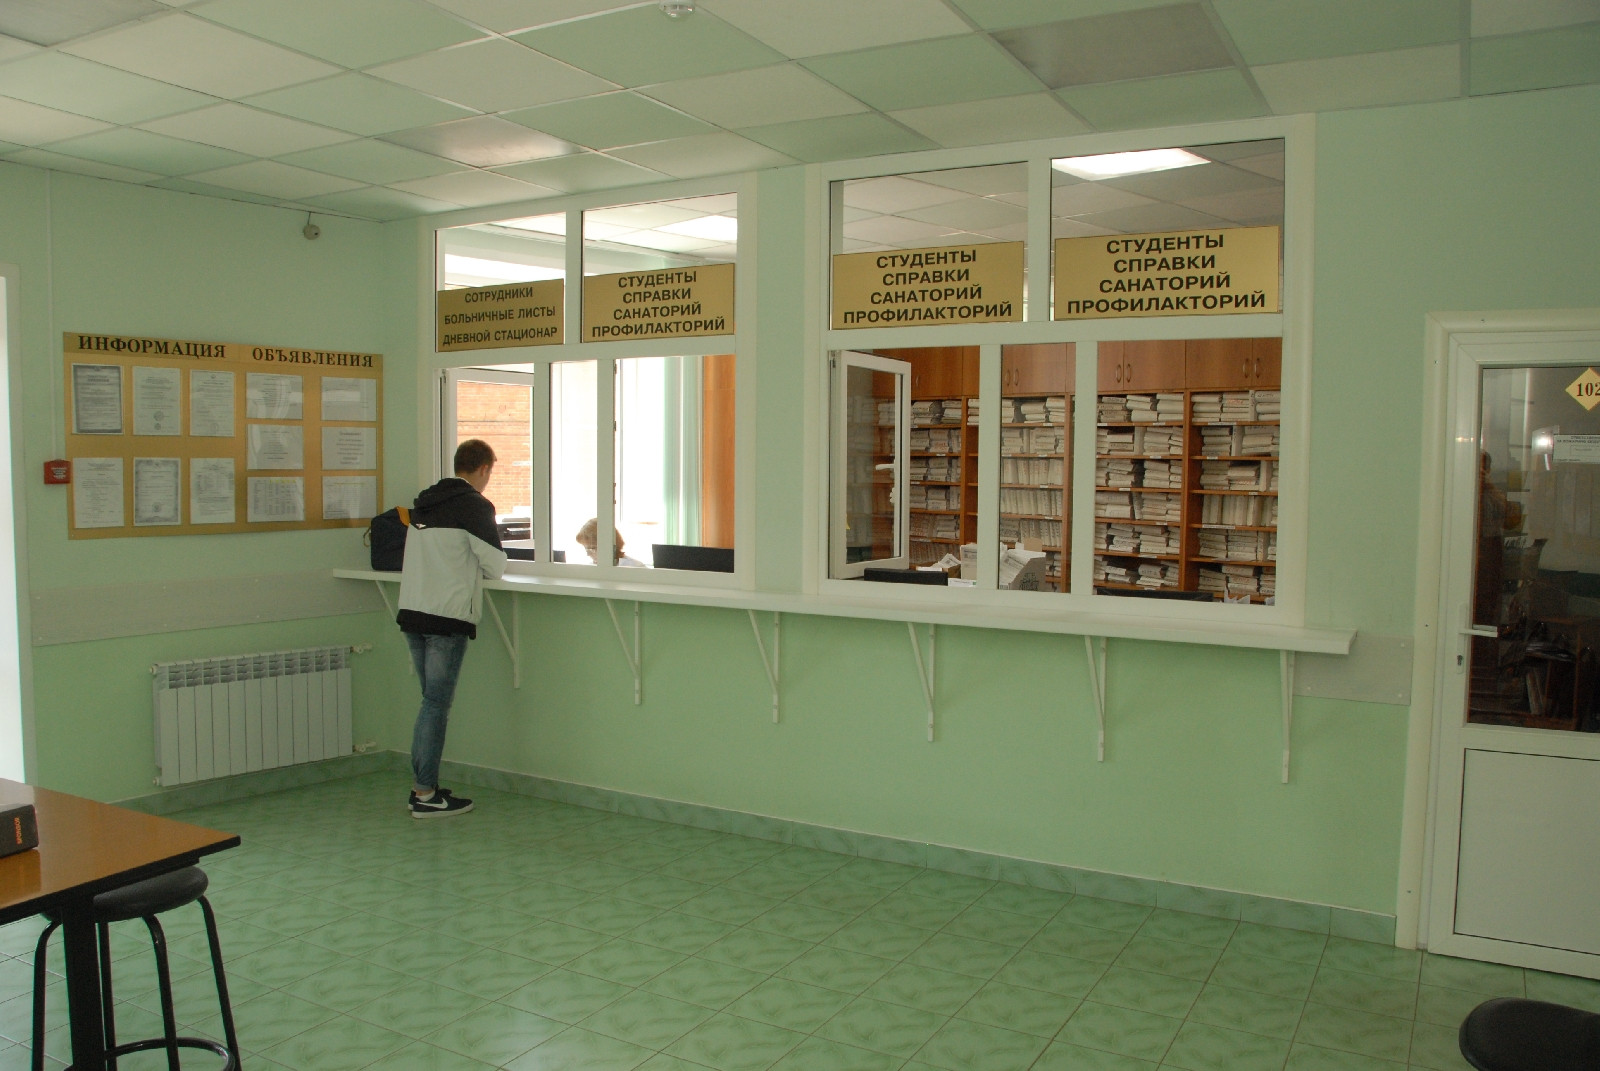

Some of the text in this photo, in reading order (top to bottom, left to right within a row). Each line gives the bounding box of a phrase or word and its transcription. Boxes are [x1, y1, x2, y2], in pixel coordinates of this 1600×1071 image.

[1106, 234, 1224, 255] СТУДЕНТЫ
[876, 249, 977, 269] СТУДЕНТЫ
[1113, 255, 1216, 274] СПРАВКИ
[618, 271, 697, 288] СТУДЕНТЫ
[882, 269, 970, 287] СПРАВКИ
[1099, 271, 1231, 294] САНАТОРИЙ
[464, 286, 533, 303] СОТРУДНИКИ
[622, 288, 691, 304] СПРАВКИ
[870, 284, 982, 306] САНАТОРИЙ
[1067, 290, 1266, 315] ПРОФИЛАКТОРИЙ
[444, 306, 556, 325] БОЛЬНИЧНЫЕ ЛИСТЫ
[613, 301, 701, 321] САНАТОРИЙ
[843, 301, 1013, 325] ПРОФИЛАКТОРИЙ
[442, 326, 558, 346] ДНЕВНОЙ СТАЦИОНАР
[592, 316, 725, 338] ПРОФИЛАКТОРИЙ
[78, 335, 227, 359] ИНФОРМАЦИЯ
[252, 347, 374, 368] ОБЪЯВЛЕНИЯ
